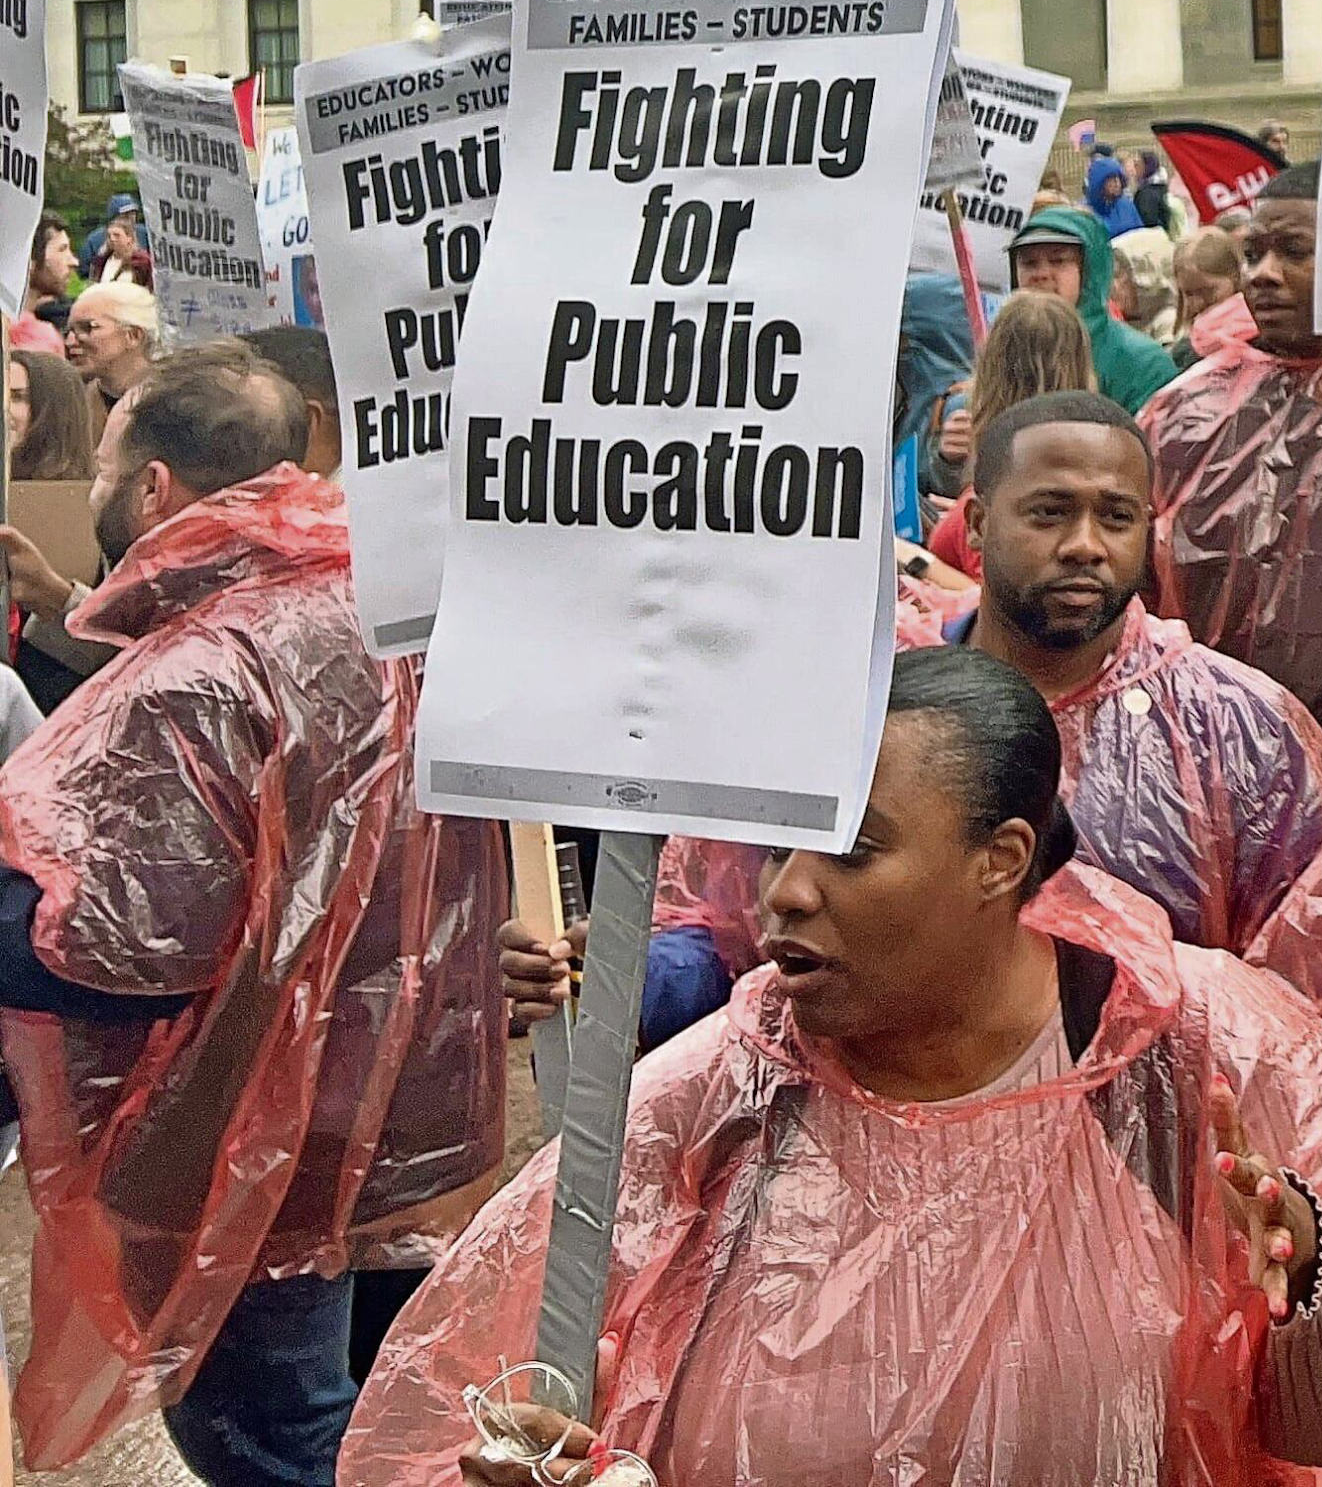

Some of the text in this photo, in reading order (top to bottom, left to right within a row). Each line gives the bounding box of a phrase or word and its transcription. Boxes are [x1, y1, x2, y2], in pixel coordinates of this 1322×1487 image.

[568, 12, 699, 44] FAMILIES
[732, 2, 884, 38] STUDENTS
[316, 68, 445, 119] EDUCATORS
[338, 103, 430, 145] FAMILIES
[552, 64, 877, 182] Fighting
[0, 135, 38, 197] ion
[143, 120, 240, 176] Fighting
[342, 126, 502, 233] Fighti
[158, 198, 236, 247] Public
[630, 184, 755, 286] for
[541, 299, 803, 411] Public
[465, 416, 865, 540] Education
